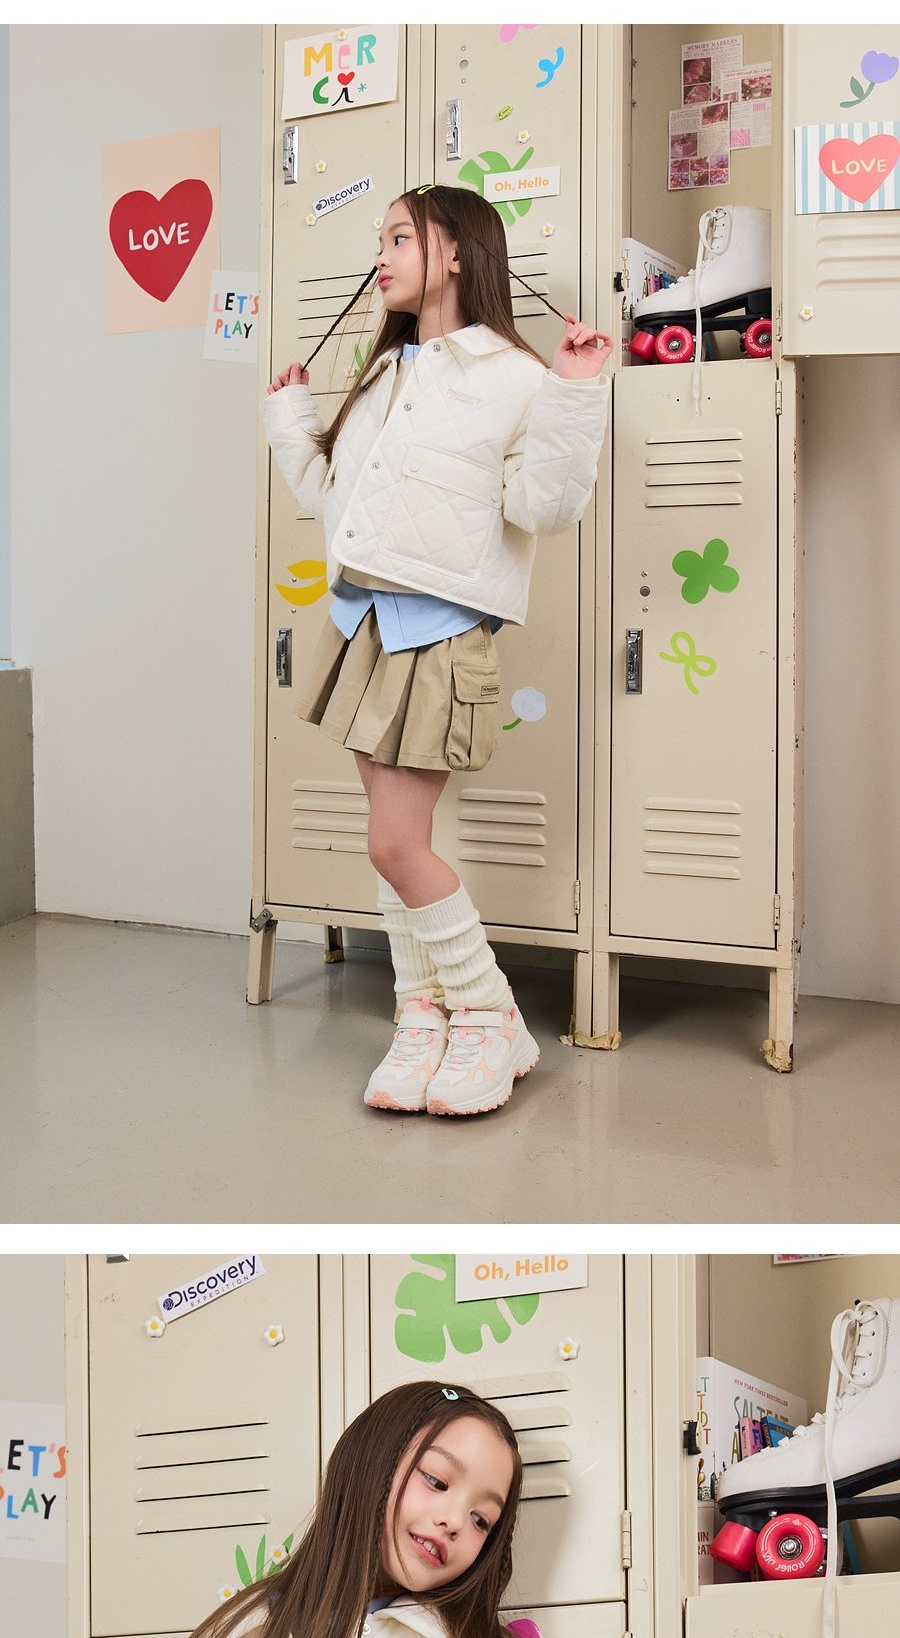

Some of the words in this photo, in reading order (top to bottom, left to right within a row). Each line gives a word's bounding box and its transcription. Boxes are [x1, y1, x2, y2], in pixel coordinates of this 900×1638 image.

[831, 157, 887, 175] LOVE
[315, 178, 370, 211] Discovery
[494, 180, 515, 192] Oh,
[518, 176, 550, 189] Hello
[128, 222, 190, 251] LOVE
[213, 292, 259, 315] LET'S
[214, 318, 253, 339] PLAY
[473, 1262, 511, 1281] Oh,
[515, 1255, 569, 1277] Hello
[162, 1255, 256, 1311] Discovery
[190, 1276, 249, 1308] EXPEDITION
[0, 1439, 67, 1479] ET'S
